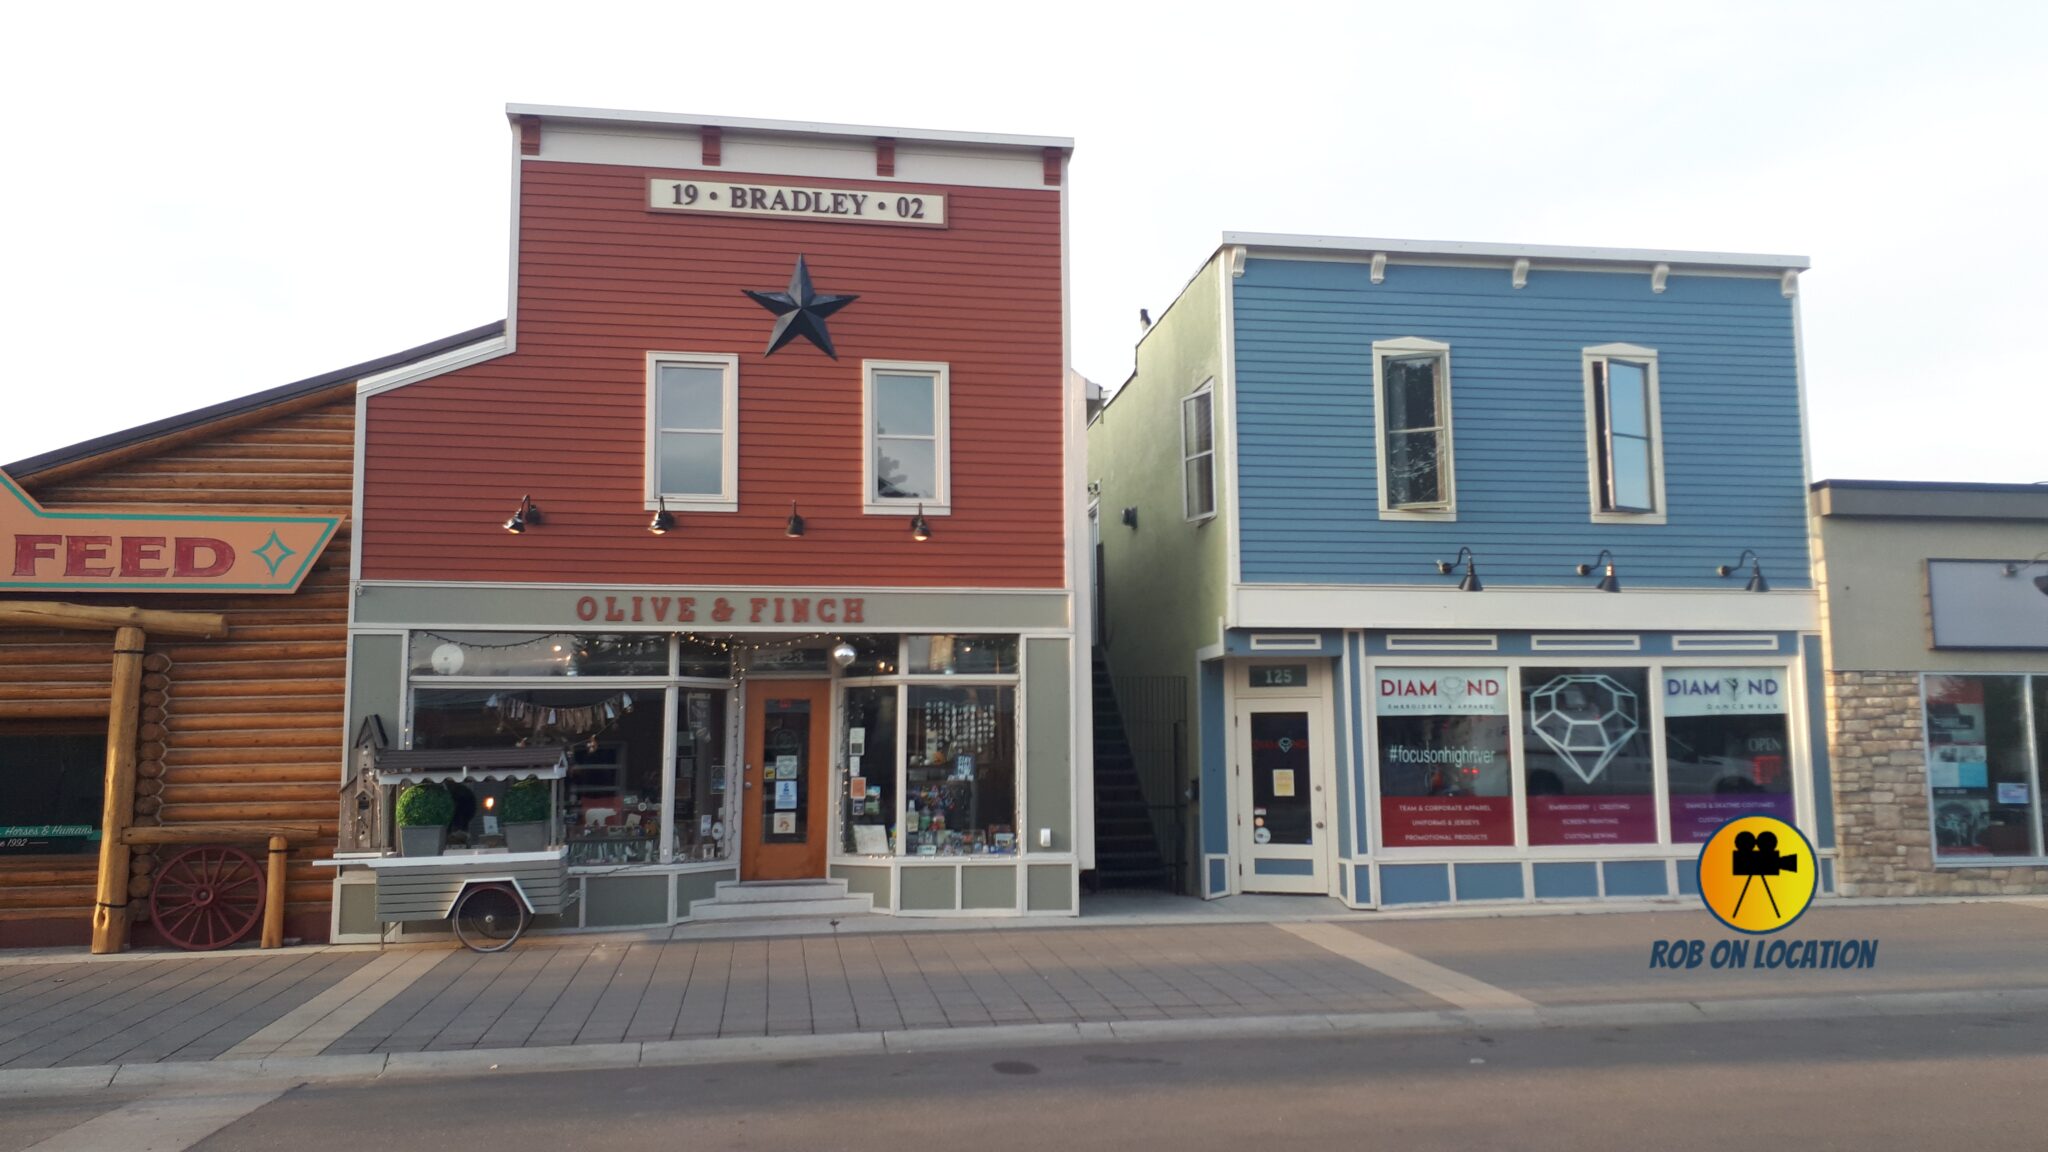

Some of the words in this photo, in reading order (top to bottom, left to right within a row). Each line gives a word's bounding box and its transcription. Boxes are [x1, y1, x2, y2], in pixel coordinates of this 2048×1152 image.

[672, 184, 698, 205] 19
[729, 186, 868, 216] BRADLEY
[896, 196, 924, 219] 02
[13, 533, 236, 579] FEED
[576, 596, 696, 622] OLIVE
[711, 597, 735, 622] &
[749, 597, 865, 623] FINCH
[1266, 670, 1292, 684] 125
[1748, 738, 1781, 752] OPEN
[1388, 744, 1496, 768] #focusonhighriver
[5, 826, 39, 836] Horses
[41, 825, 50, 836] &
[52, 824, 93, 836] Humans
[7, 838, 28, 847] 1992
